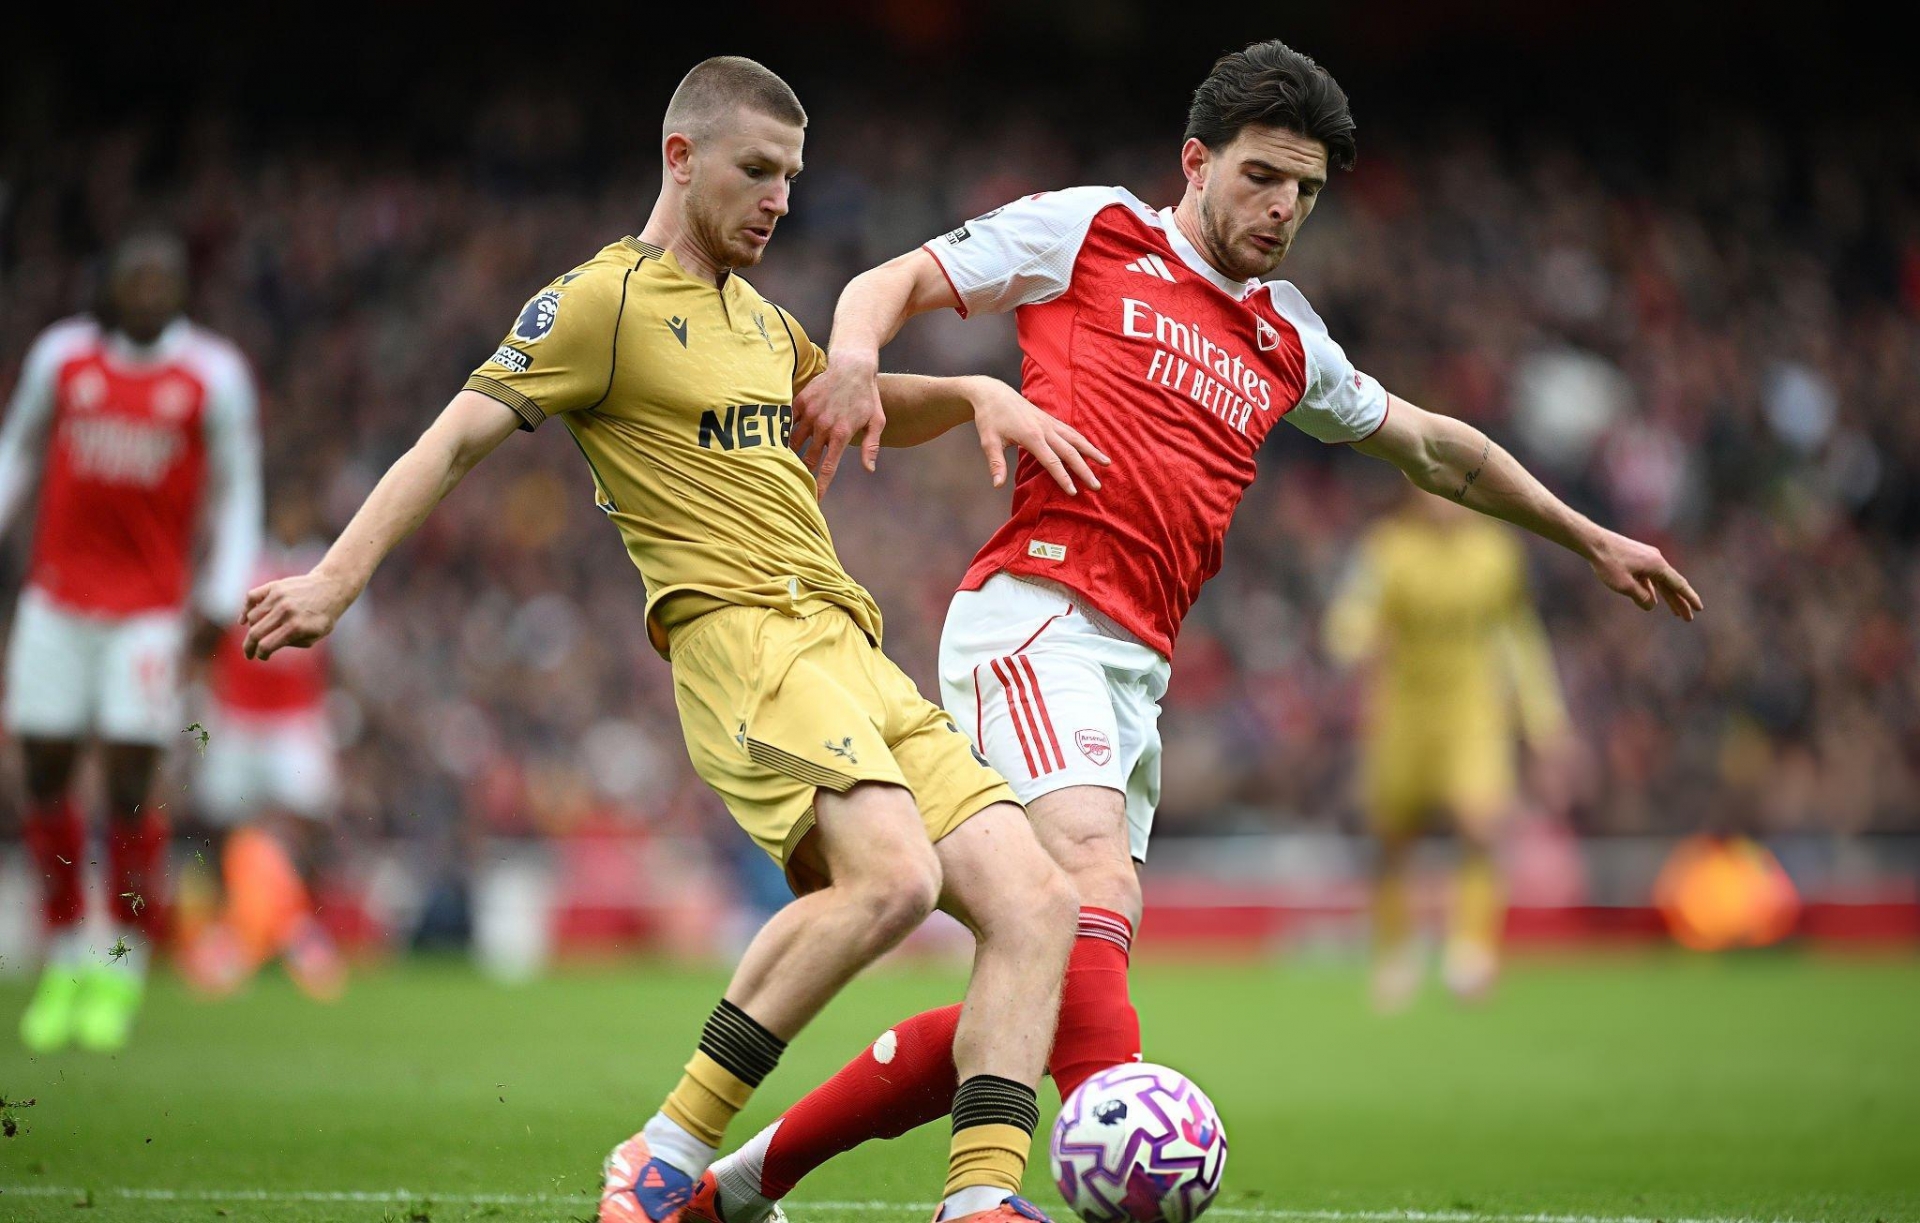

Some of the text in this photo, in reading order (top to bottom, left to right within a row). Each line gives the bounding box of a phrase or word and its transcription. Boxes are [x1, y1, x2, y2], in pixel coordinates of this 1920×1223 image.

[1121, 297, 1271, 411] Emirates
[1146, 349, 1253, 435] FLY BETTER
